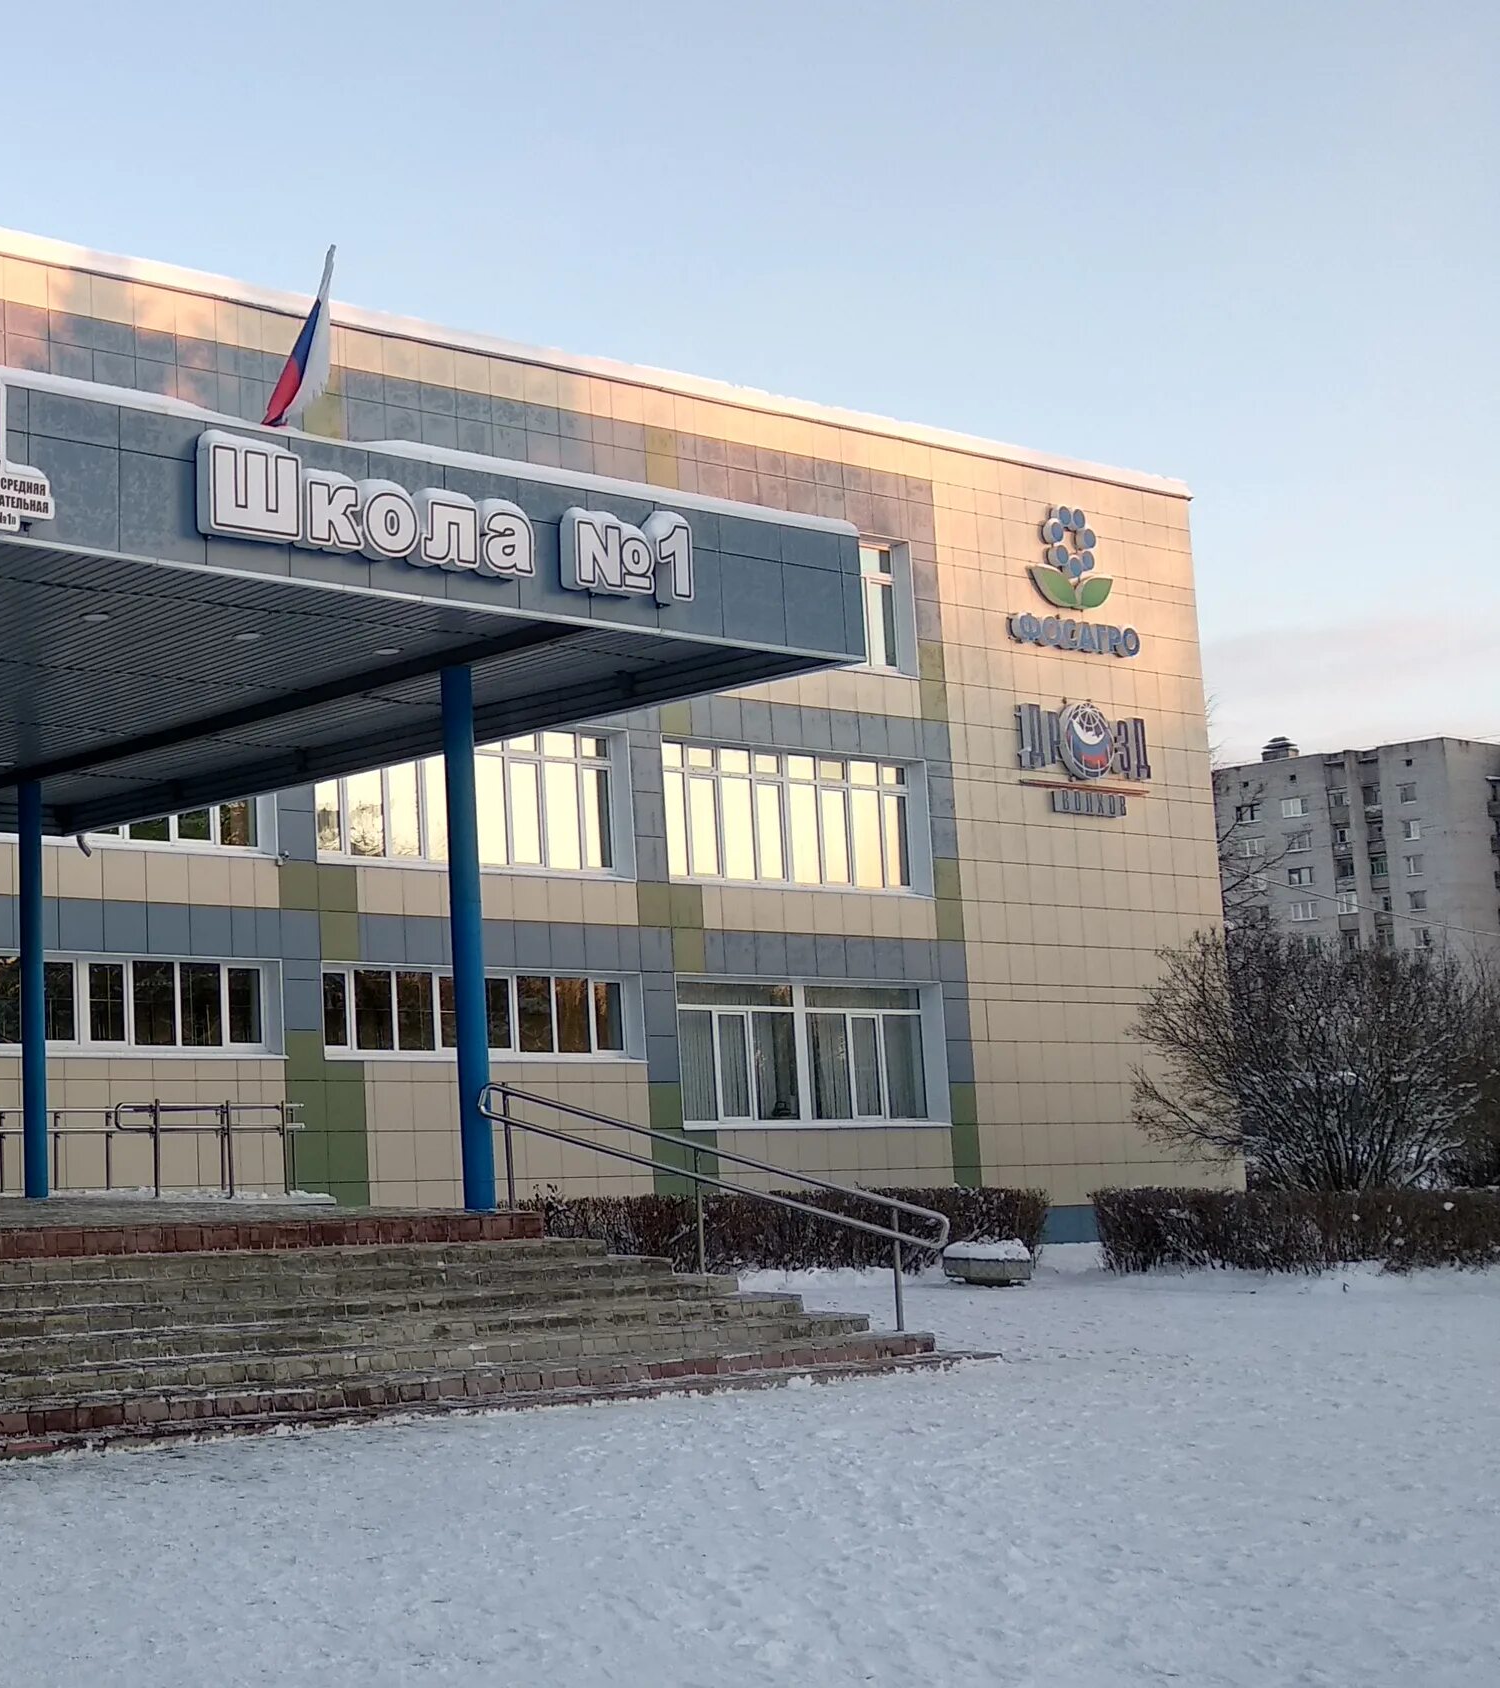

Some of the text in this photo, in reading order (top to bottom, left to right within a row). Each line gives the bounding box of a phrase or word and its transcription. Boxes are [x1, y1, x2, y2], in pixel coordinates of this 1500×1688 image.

[0, 477, 47, 496] СРЕДНЯЯ
[210, 443, 693, 600] Школа №1
[1018, 613, 1140, 656] ФОСАГРО
[1060, 788, 1127, 816] ВОЛХОВ
